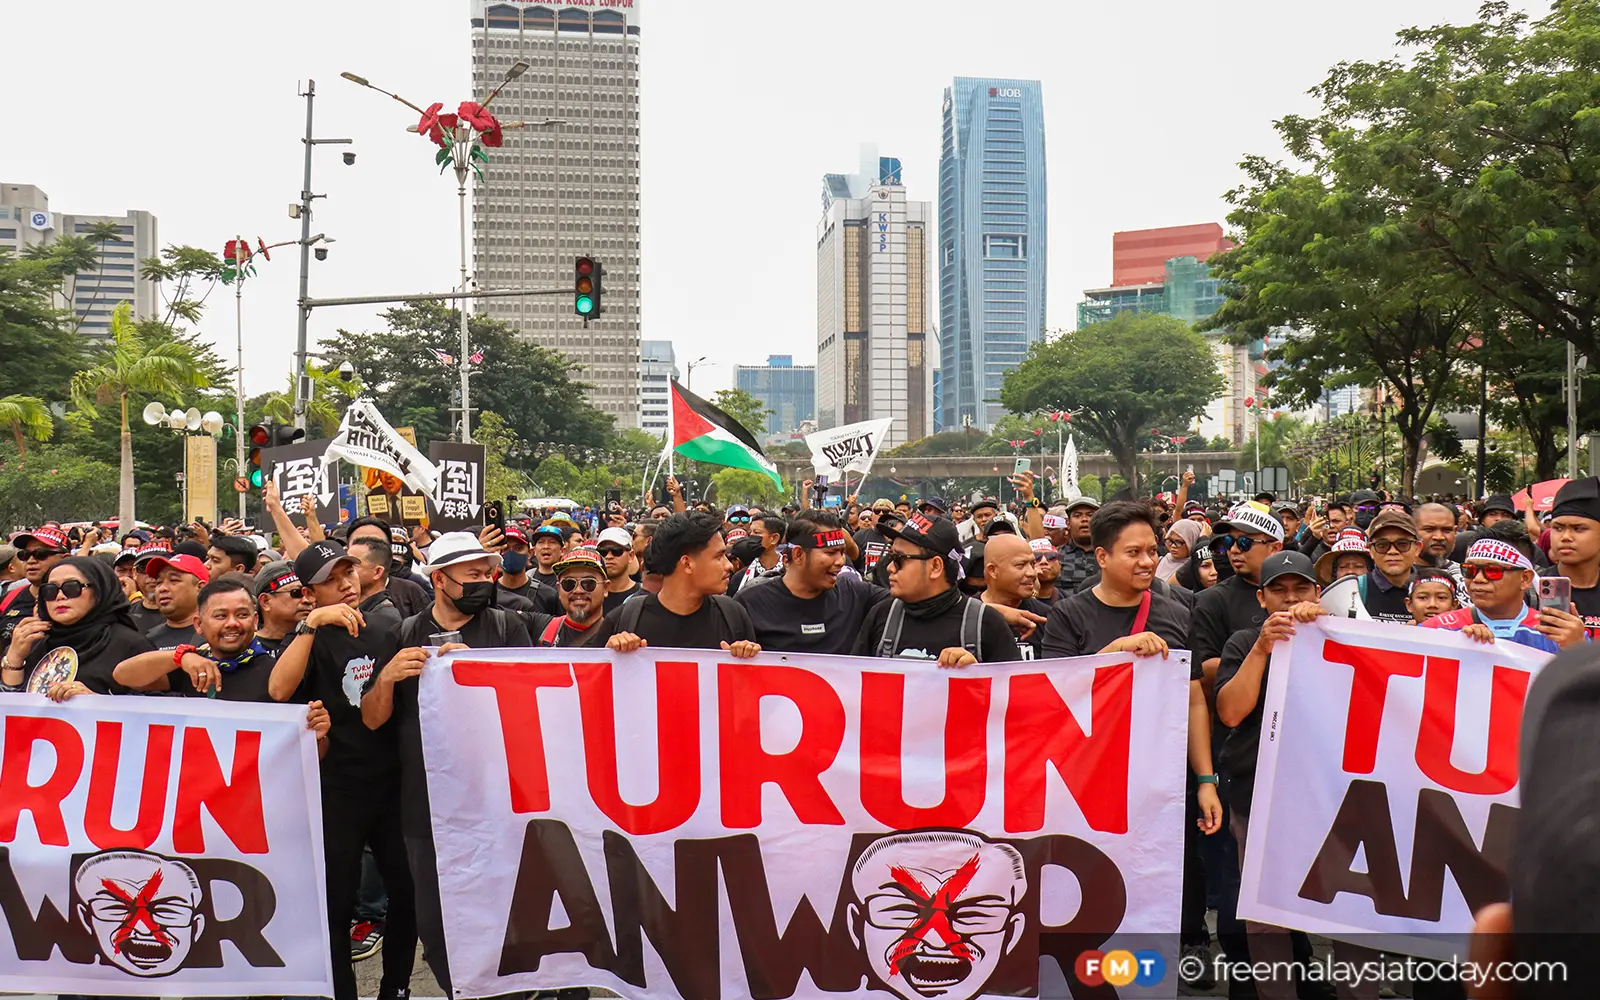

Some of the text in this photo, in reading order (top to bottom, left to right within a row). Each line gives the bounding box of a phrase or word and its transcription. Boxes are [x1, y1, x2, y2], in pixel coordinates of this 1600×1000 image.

[600, 0, 634, 8] LUMPUR
[999, 88, 1021, 98] UOB
[878, 213, 888, 252] KWSP
[444, 500, 468, 520] 安华
[1241, 511, 1278, 535] ANWAR
[315, 544, 336, 559] LA
[452, 659, 1134, 835] TURUN
[497, 818, 1128, 1000] ANWR
